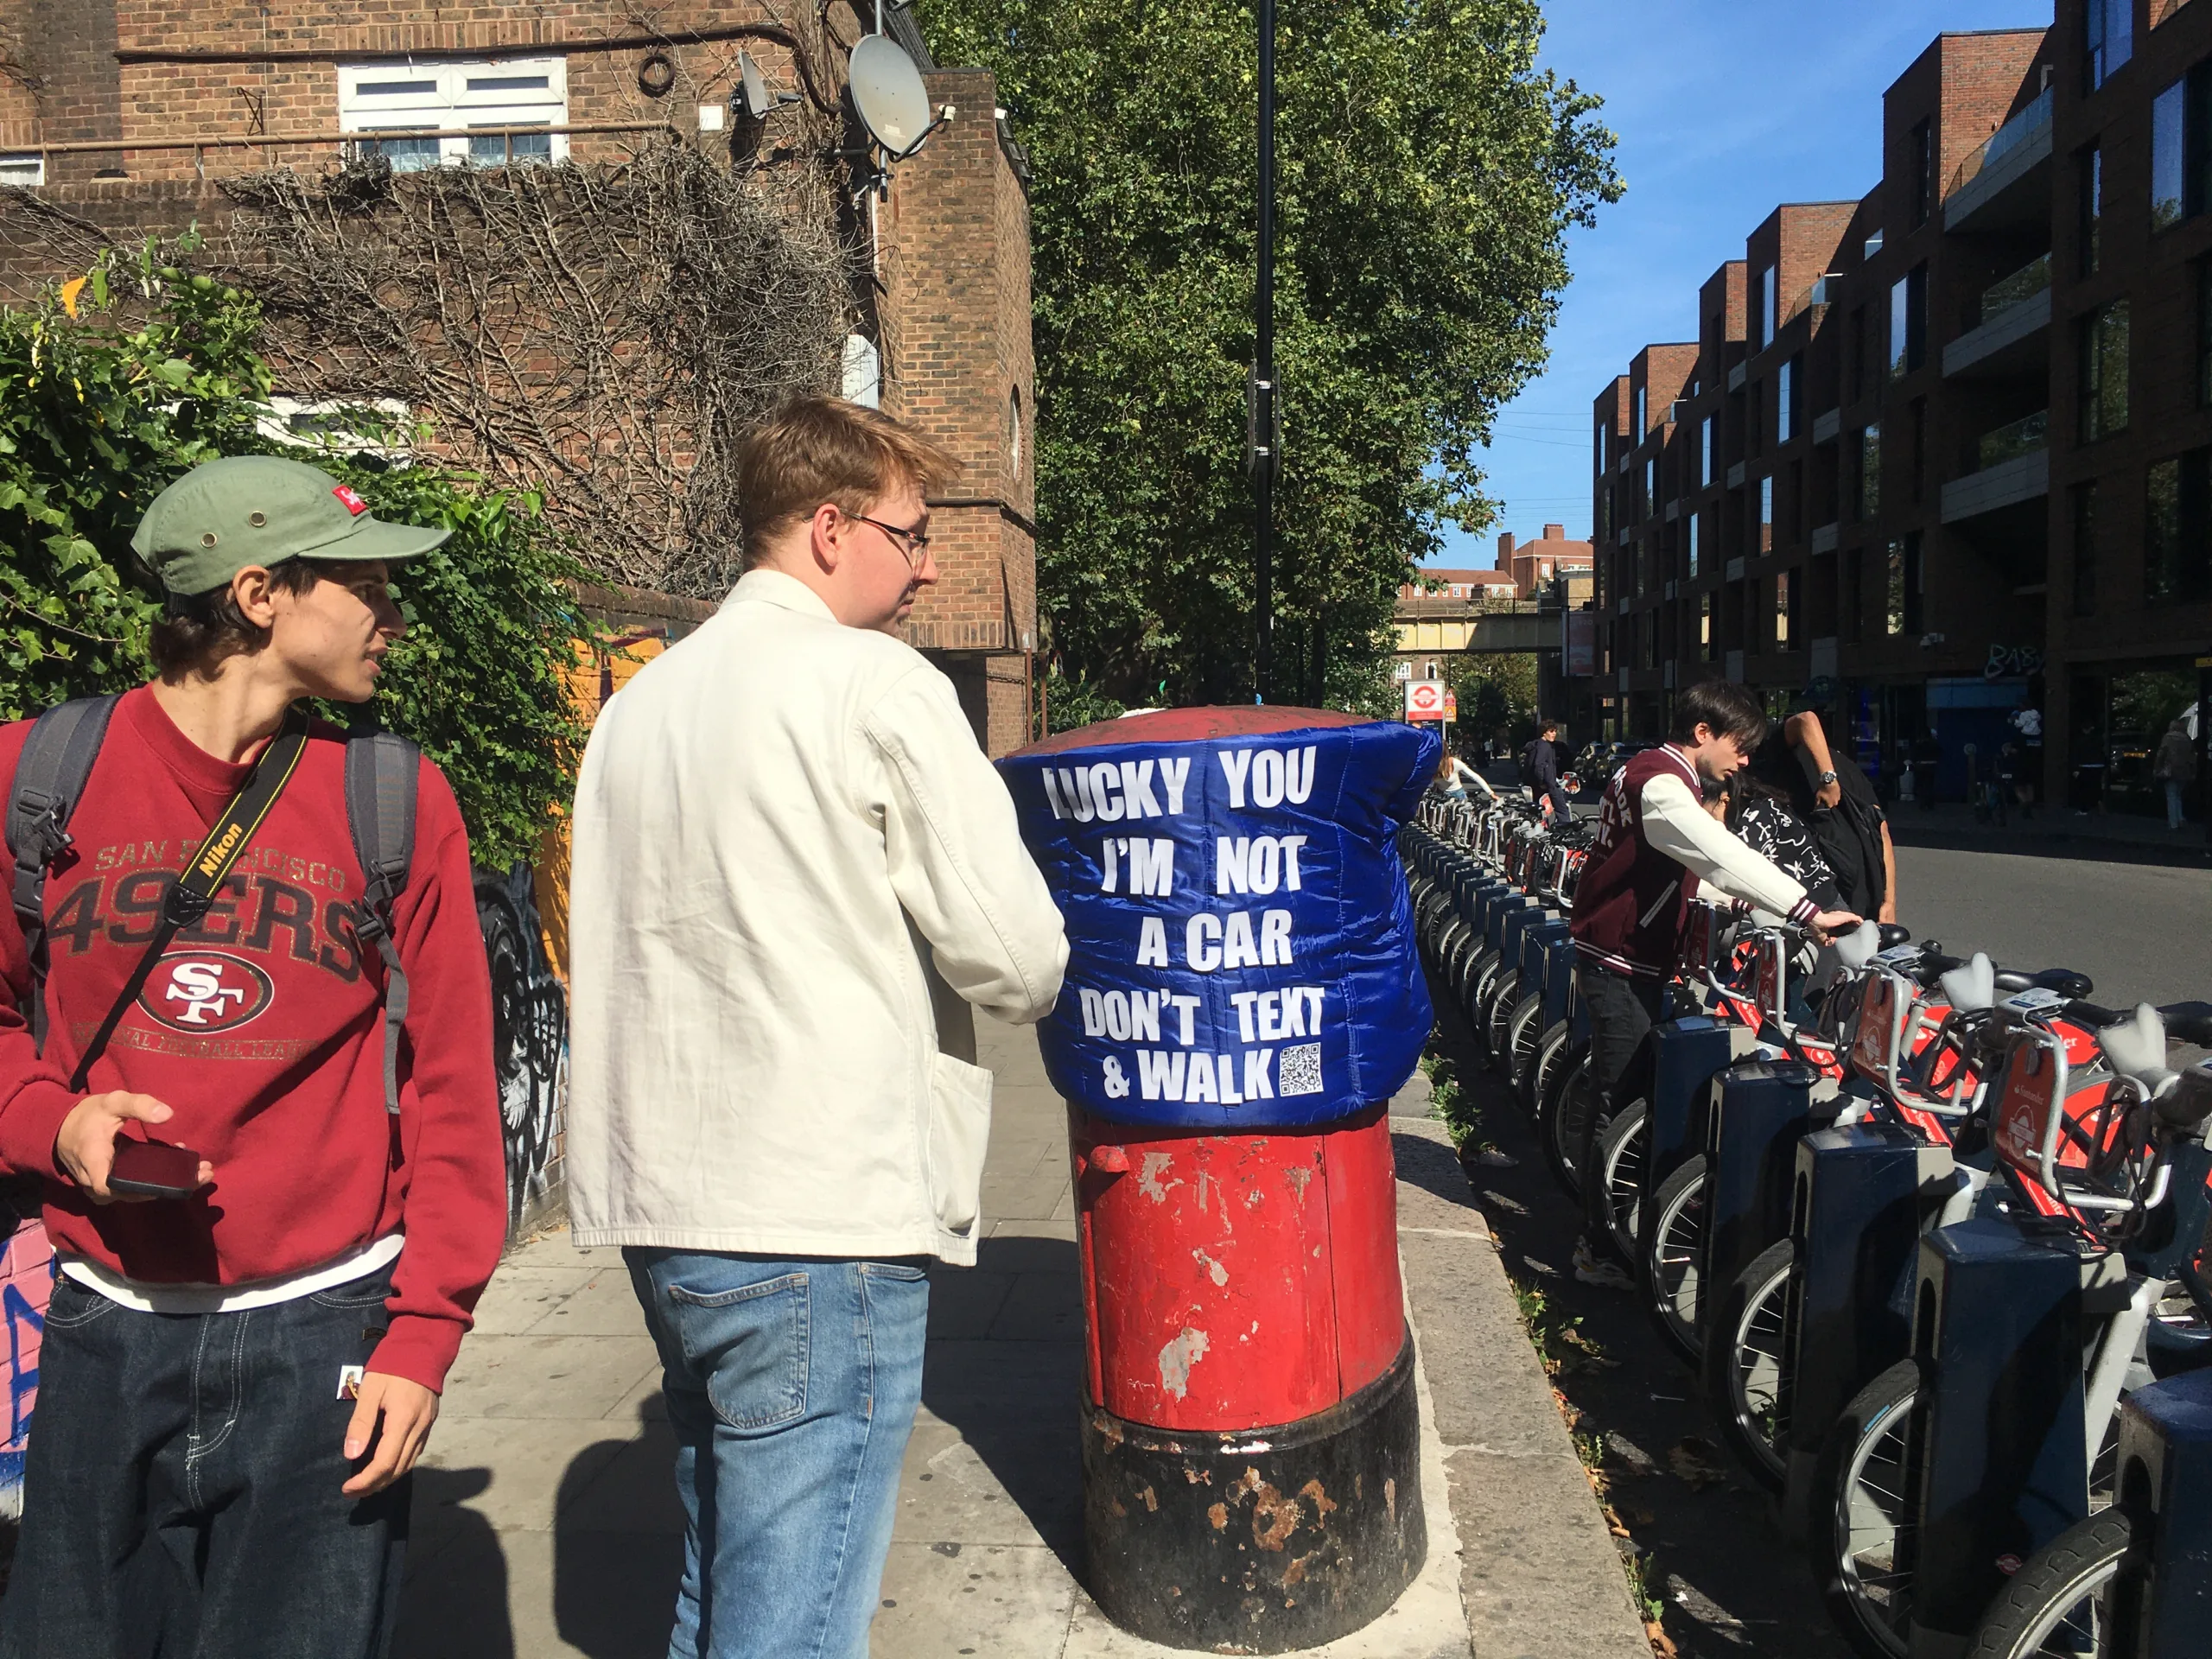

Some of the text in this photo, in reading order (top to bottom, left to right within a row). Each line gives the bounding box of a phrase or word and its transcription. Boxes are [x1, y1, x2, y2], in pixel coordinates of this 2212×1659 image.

[1043, 746, 1317, 823] LUCKY YOU
[95, 840, 168, 871] SAN
[200, 823, 243, 877] Nikon
[1102, 836, 1307, 896] I'M NOT
[44, 867, 362, 983] 49ERS
[1136, 909, 1293, 972] A CAR
[1080, 987, 1325, 1046] DON'T TEXT
[1103, 1048, 1274, 1104] & WALK
